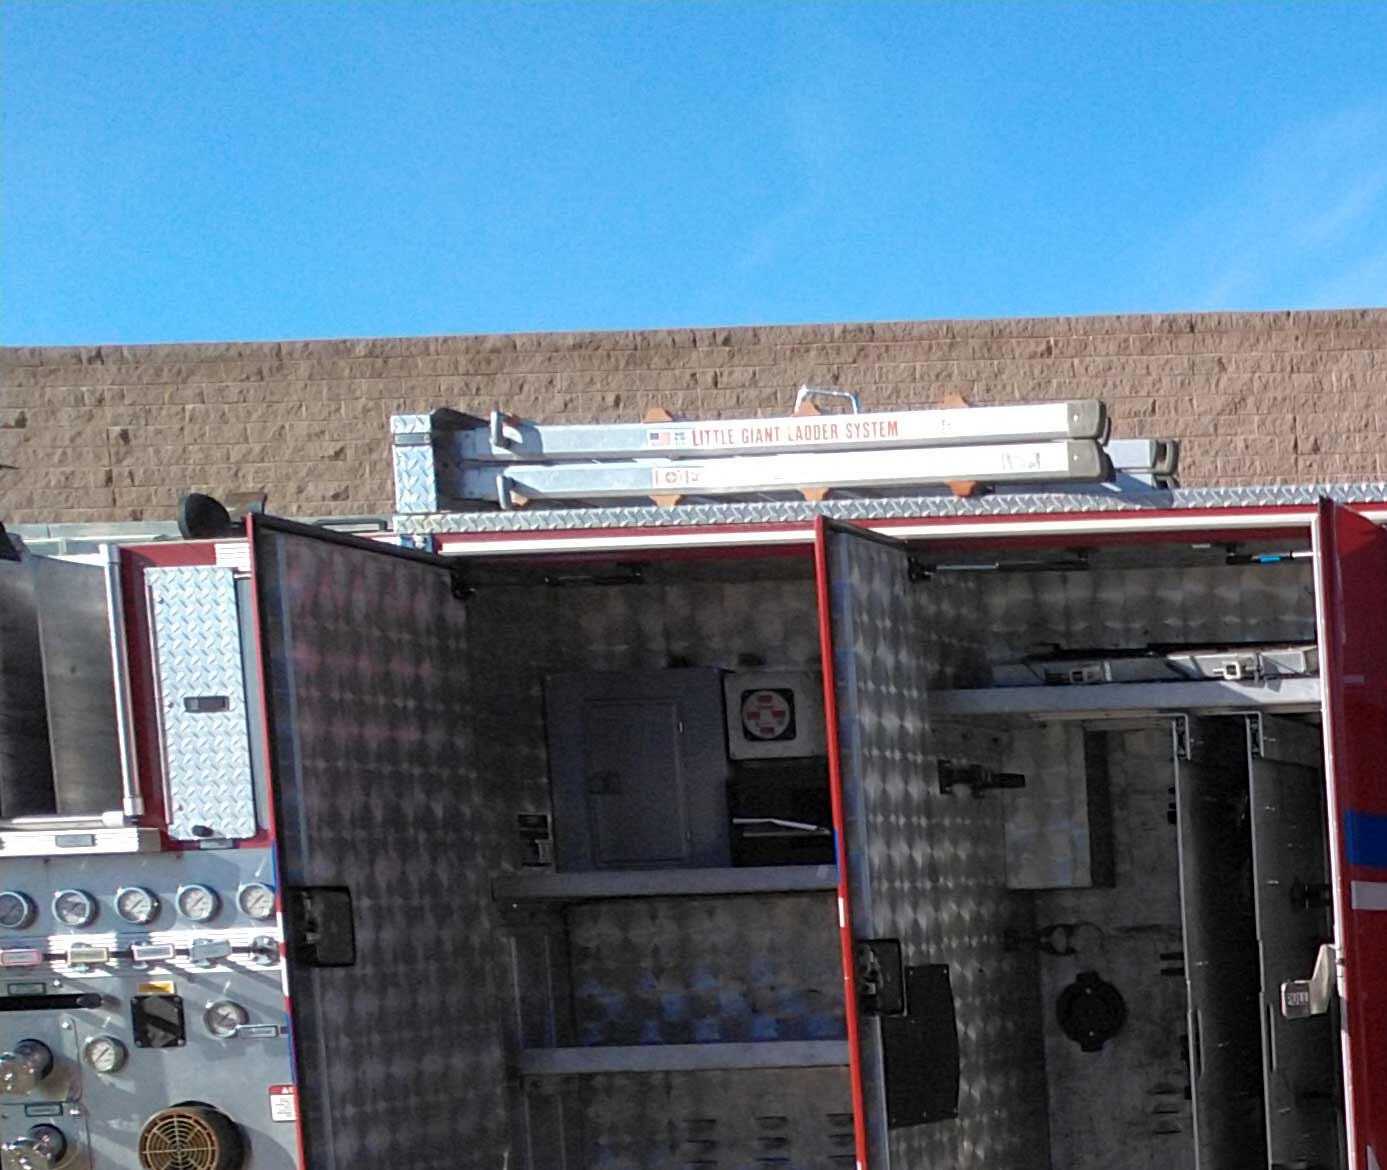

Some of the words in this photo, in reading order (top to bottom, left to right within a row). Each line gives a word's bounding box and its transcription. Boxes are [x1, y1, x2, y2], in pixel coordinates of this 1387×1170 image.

[692, 428, 734, 446] LITTLE
[742, 425, 780, 444] GIANT
[787, 423, 838, 441] LADDER
[846, 421, 898, 439] SYSTEM
